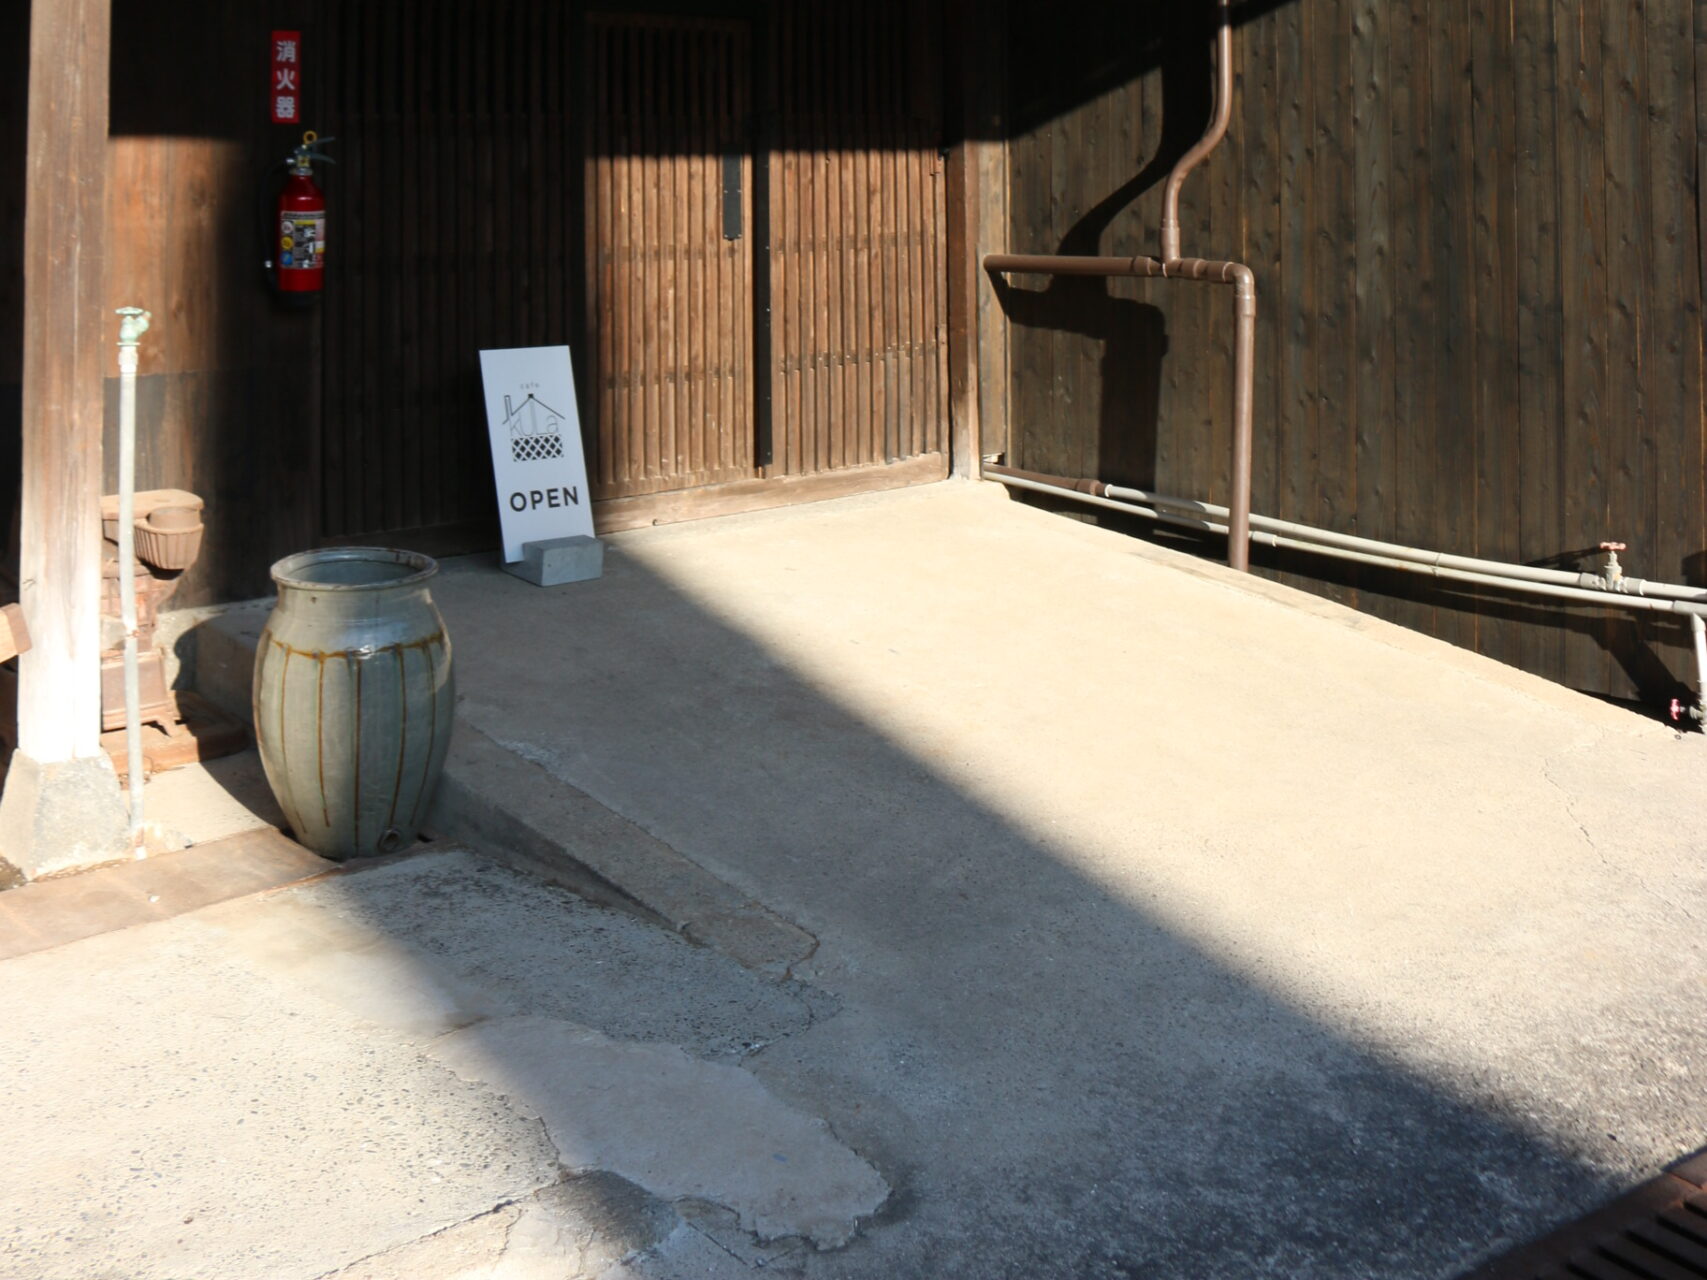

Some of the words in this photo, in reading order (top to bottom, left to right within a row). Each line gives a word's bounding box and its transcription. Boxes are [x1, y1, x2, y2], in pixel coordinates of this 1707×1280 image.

[276, 40, 296, 119] 消火器
[510, 486, 579, 512] OPEN
